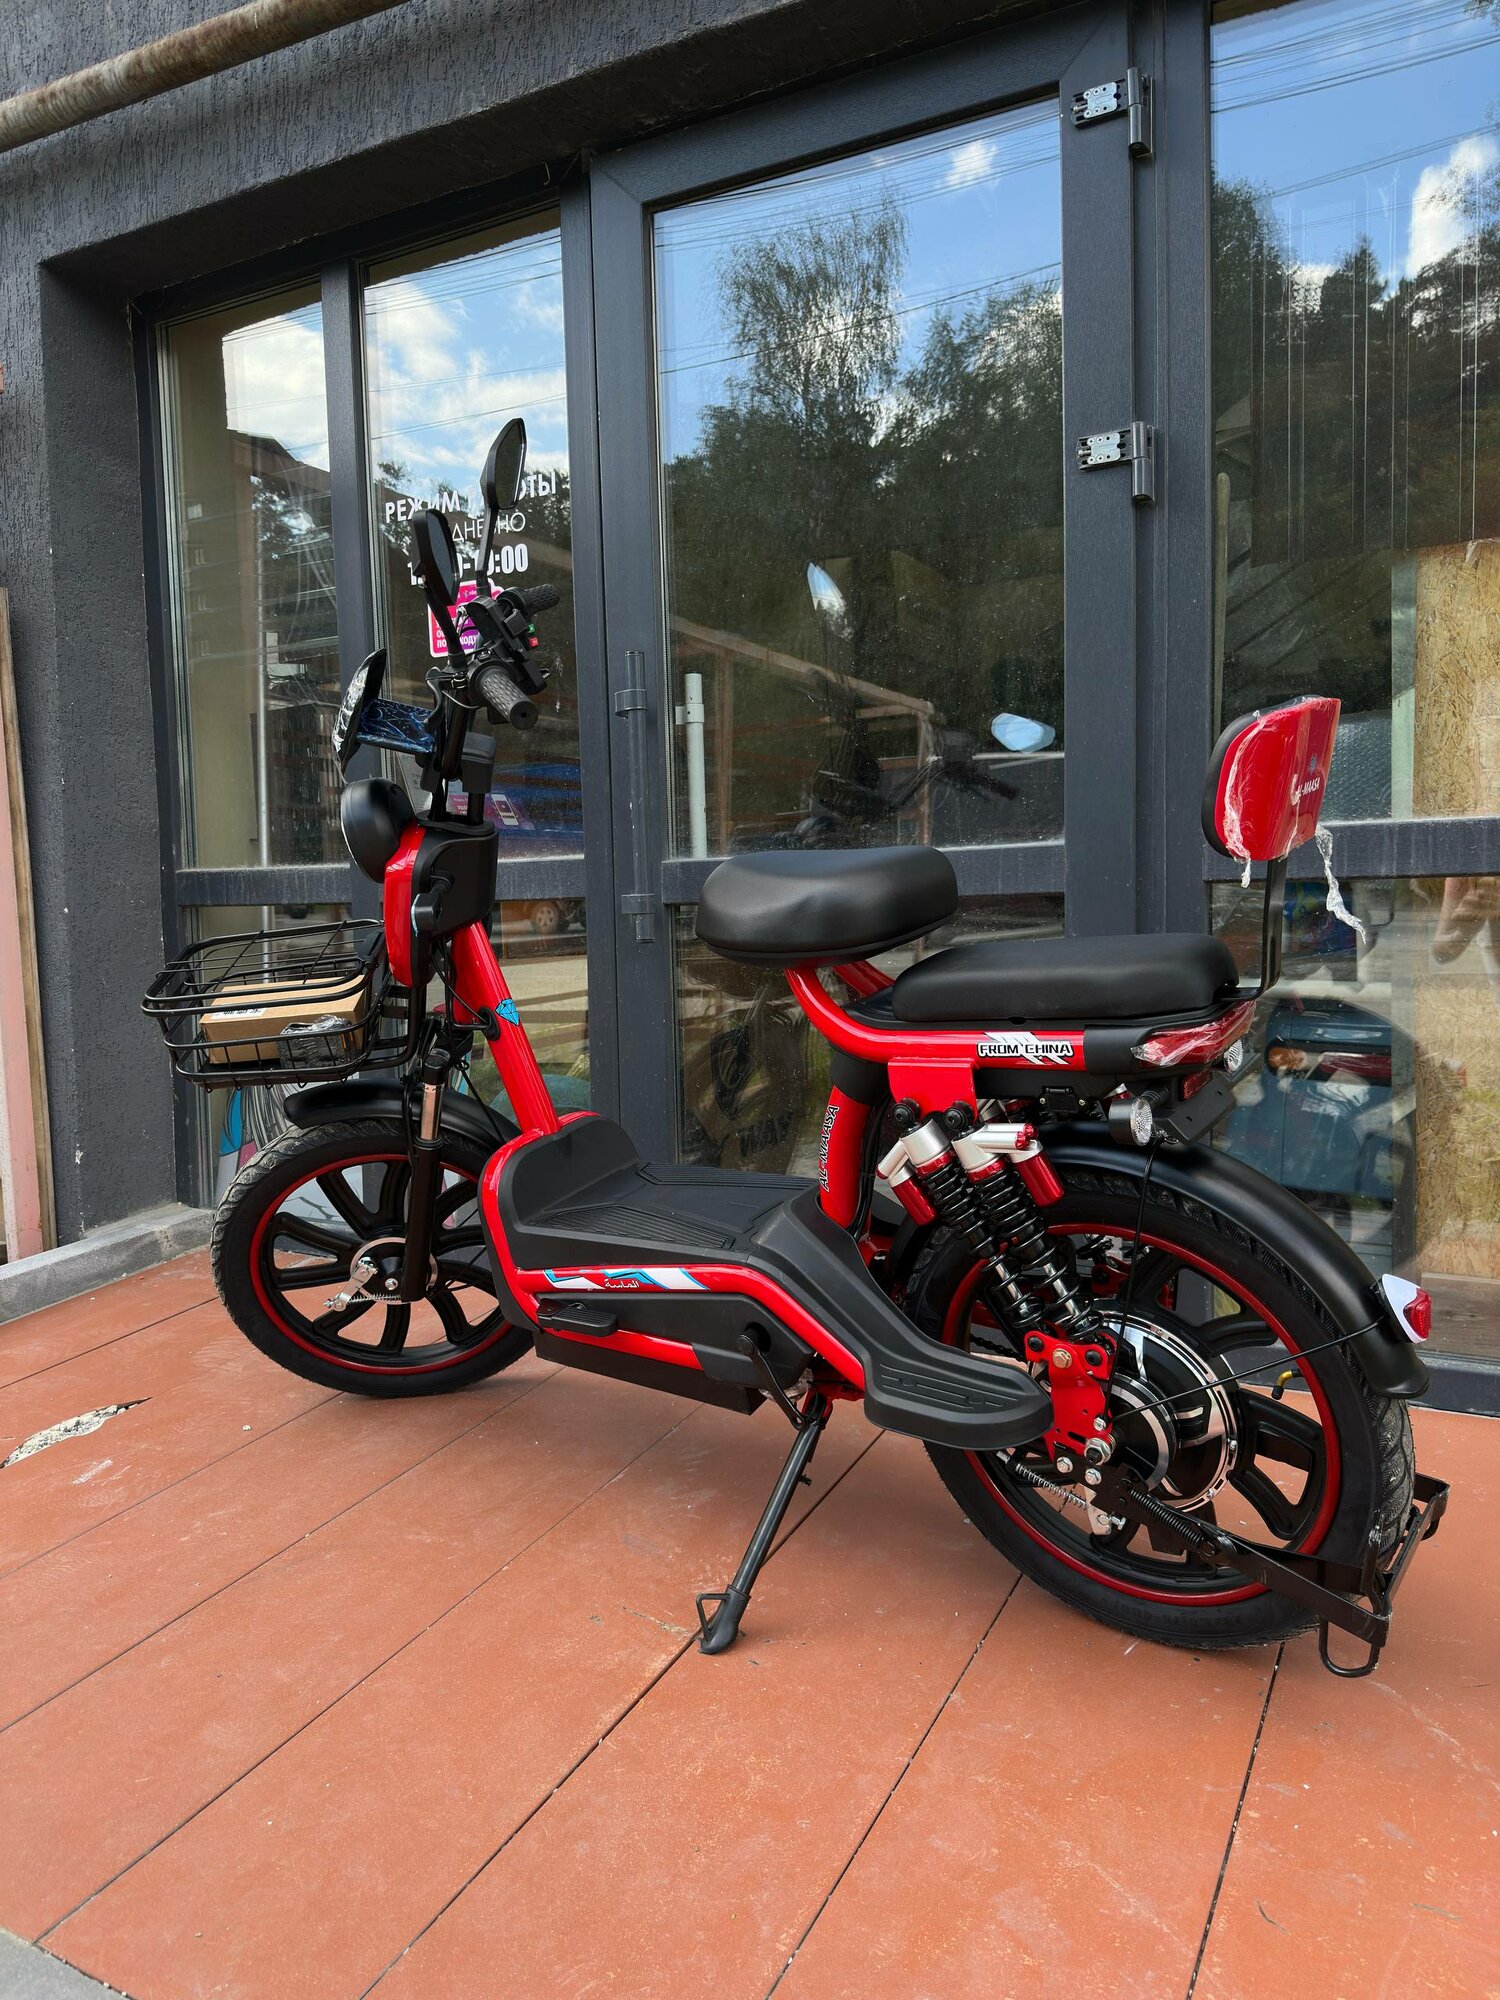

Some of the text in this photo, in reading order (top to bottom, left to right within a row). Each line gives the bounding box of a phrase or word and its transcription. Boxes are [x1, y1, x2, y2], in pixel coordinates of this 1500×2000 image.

[385, 490, 461, 524] РЕЖИМ
[979, 1044, 1019, 1055] FROM
[819, 1105, 840, 1192] AL-MAASA
